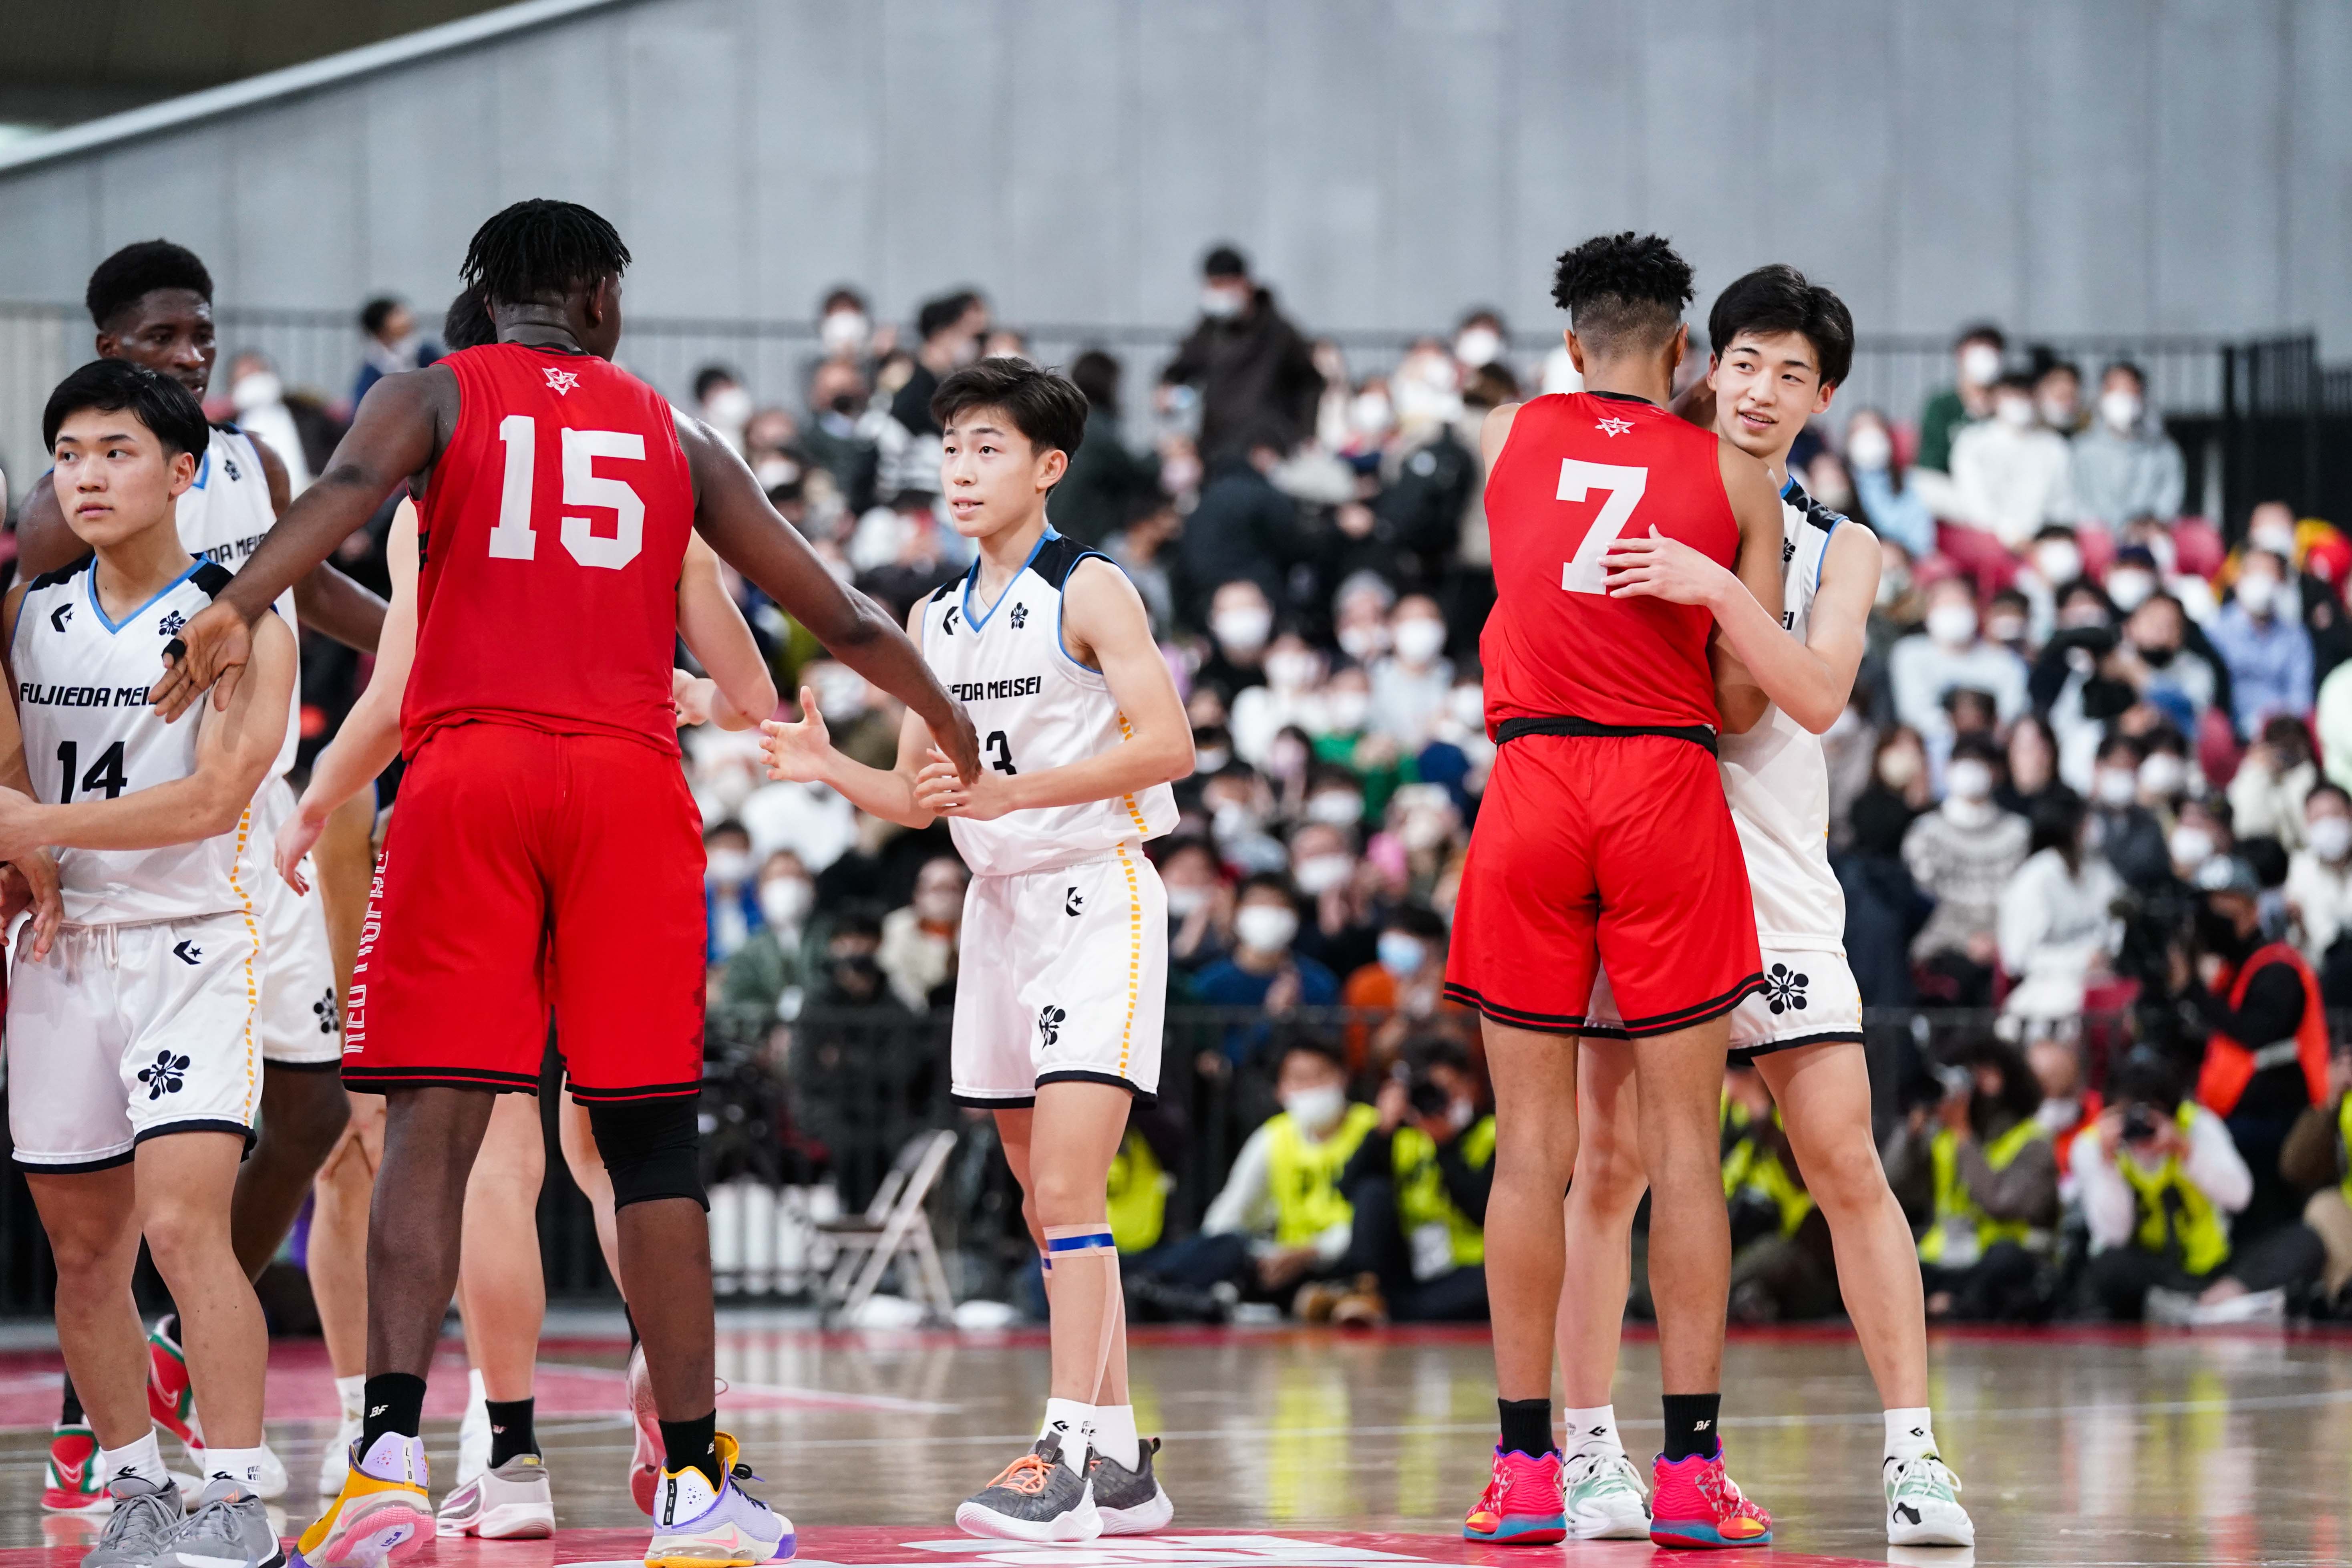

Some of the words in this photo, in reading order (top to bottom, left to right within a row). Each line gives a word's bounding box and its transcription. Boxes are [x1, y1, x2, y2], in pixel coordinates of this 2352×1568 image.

[489, 415, 646, 570] 15
[1556, 458, 1649, 594] 7
[20, 682, 111, 707] FUJIEDA
[113, 686, 157, 707] MEI
[988, 676, 1041, 700] MEISEI
[57, 741, 128, 804] 14
[1693, 1420, 1711, 1431] BF
